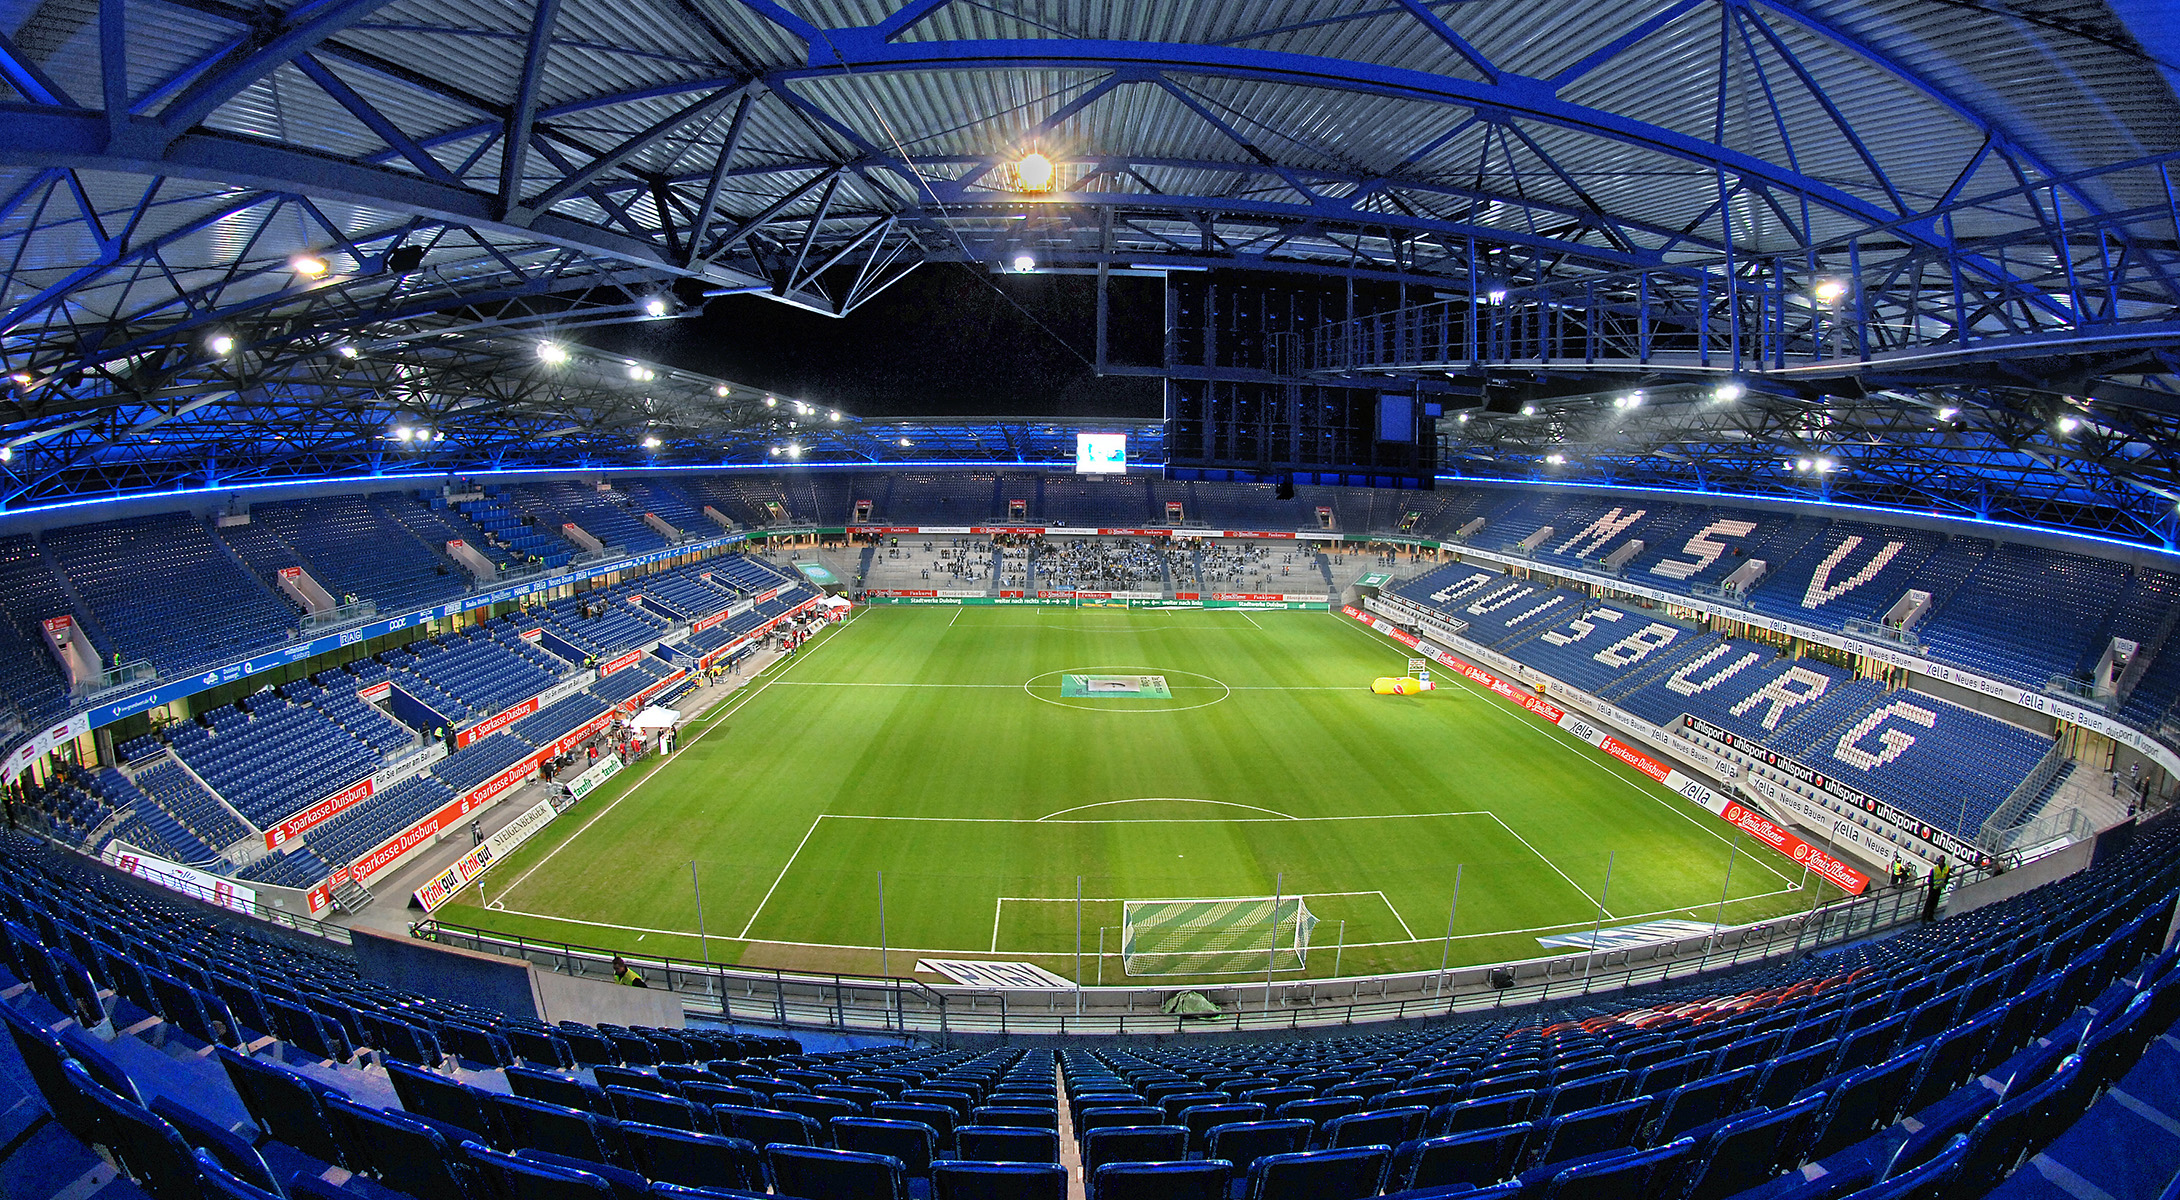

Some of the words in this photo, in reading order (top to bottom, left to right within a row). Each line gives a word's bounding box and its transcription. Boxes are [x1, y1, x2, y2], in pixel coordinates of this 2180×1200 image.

[1868, 648, 1888, 661] Neues
[1891, 653, 1912, 668] Bauen
[1955, 673, 1978, 688] Neues
[1980, 680, 2004, 697] Bauen
[2050, 702, 2074, 720] Neues
[2078, 712, 2102, 731] Bauen
[478, 714, 506, 734] Sparkasse
[506, 702, 530, 722] Duisburg
[1694, 720, 1724, 742] uhlsport
[1614, 711, 1630, 724] Neues
[1630, 718, 1646, 733] Bauen
[1672, 738, 1688, 754] Neues
[1690, 747, 1708, 764] Bauen
[1734, 738, 1766, 762] uhlsport
[376, 772, 386, 785] Für
[386, 768, 396, 780] Sie
[395, 760, 412, 776] immer
[412, 757, 420, 766] am
[420, 750, 430, 762] Ball
[1608, 738, 1638, 765] Sparkasse
[1638, 757, 1667, 782] Duisburg
[1776, 756, 1814, 784] uhlsport
[473, 776, 508, 804] Sparkasse
[508, 758, 539, 783] Duisburg
[1824, 780, 1864, 808] uhlsport
[288, 804, 331, 836] Sparkasse
[331, 784, 368, 812] Duisburg
[494, 804, 546, 846] STEIGENBERGER
[1780, 793, 1801, 811] Neues
[1804, 804, 1826, 824] Bauen
[1864, 836, 1889, 858] Neues
[1876, 804, 1920, 835] uhlsport
[1758, 818, 1786, 843] Pilsener
[1932, 832, 1978, 863] uhlsport
[352, 844, 400, 881] Sparkasse
[400, 818, 440, 852] Duisburg
[458, 844, 494, 882] trinkgut
[420, 868, 458, 910] trinkgut
[1827, 861, 1858, 886] Pilsener
